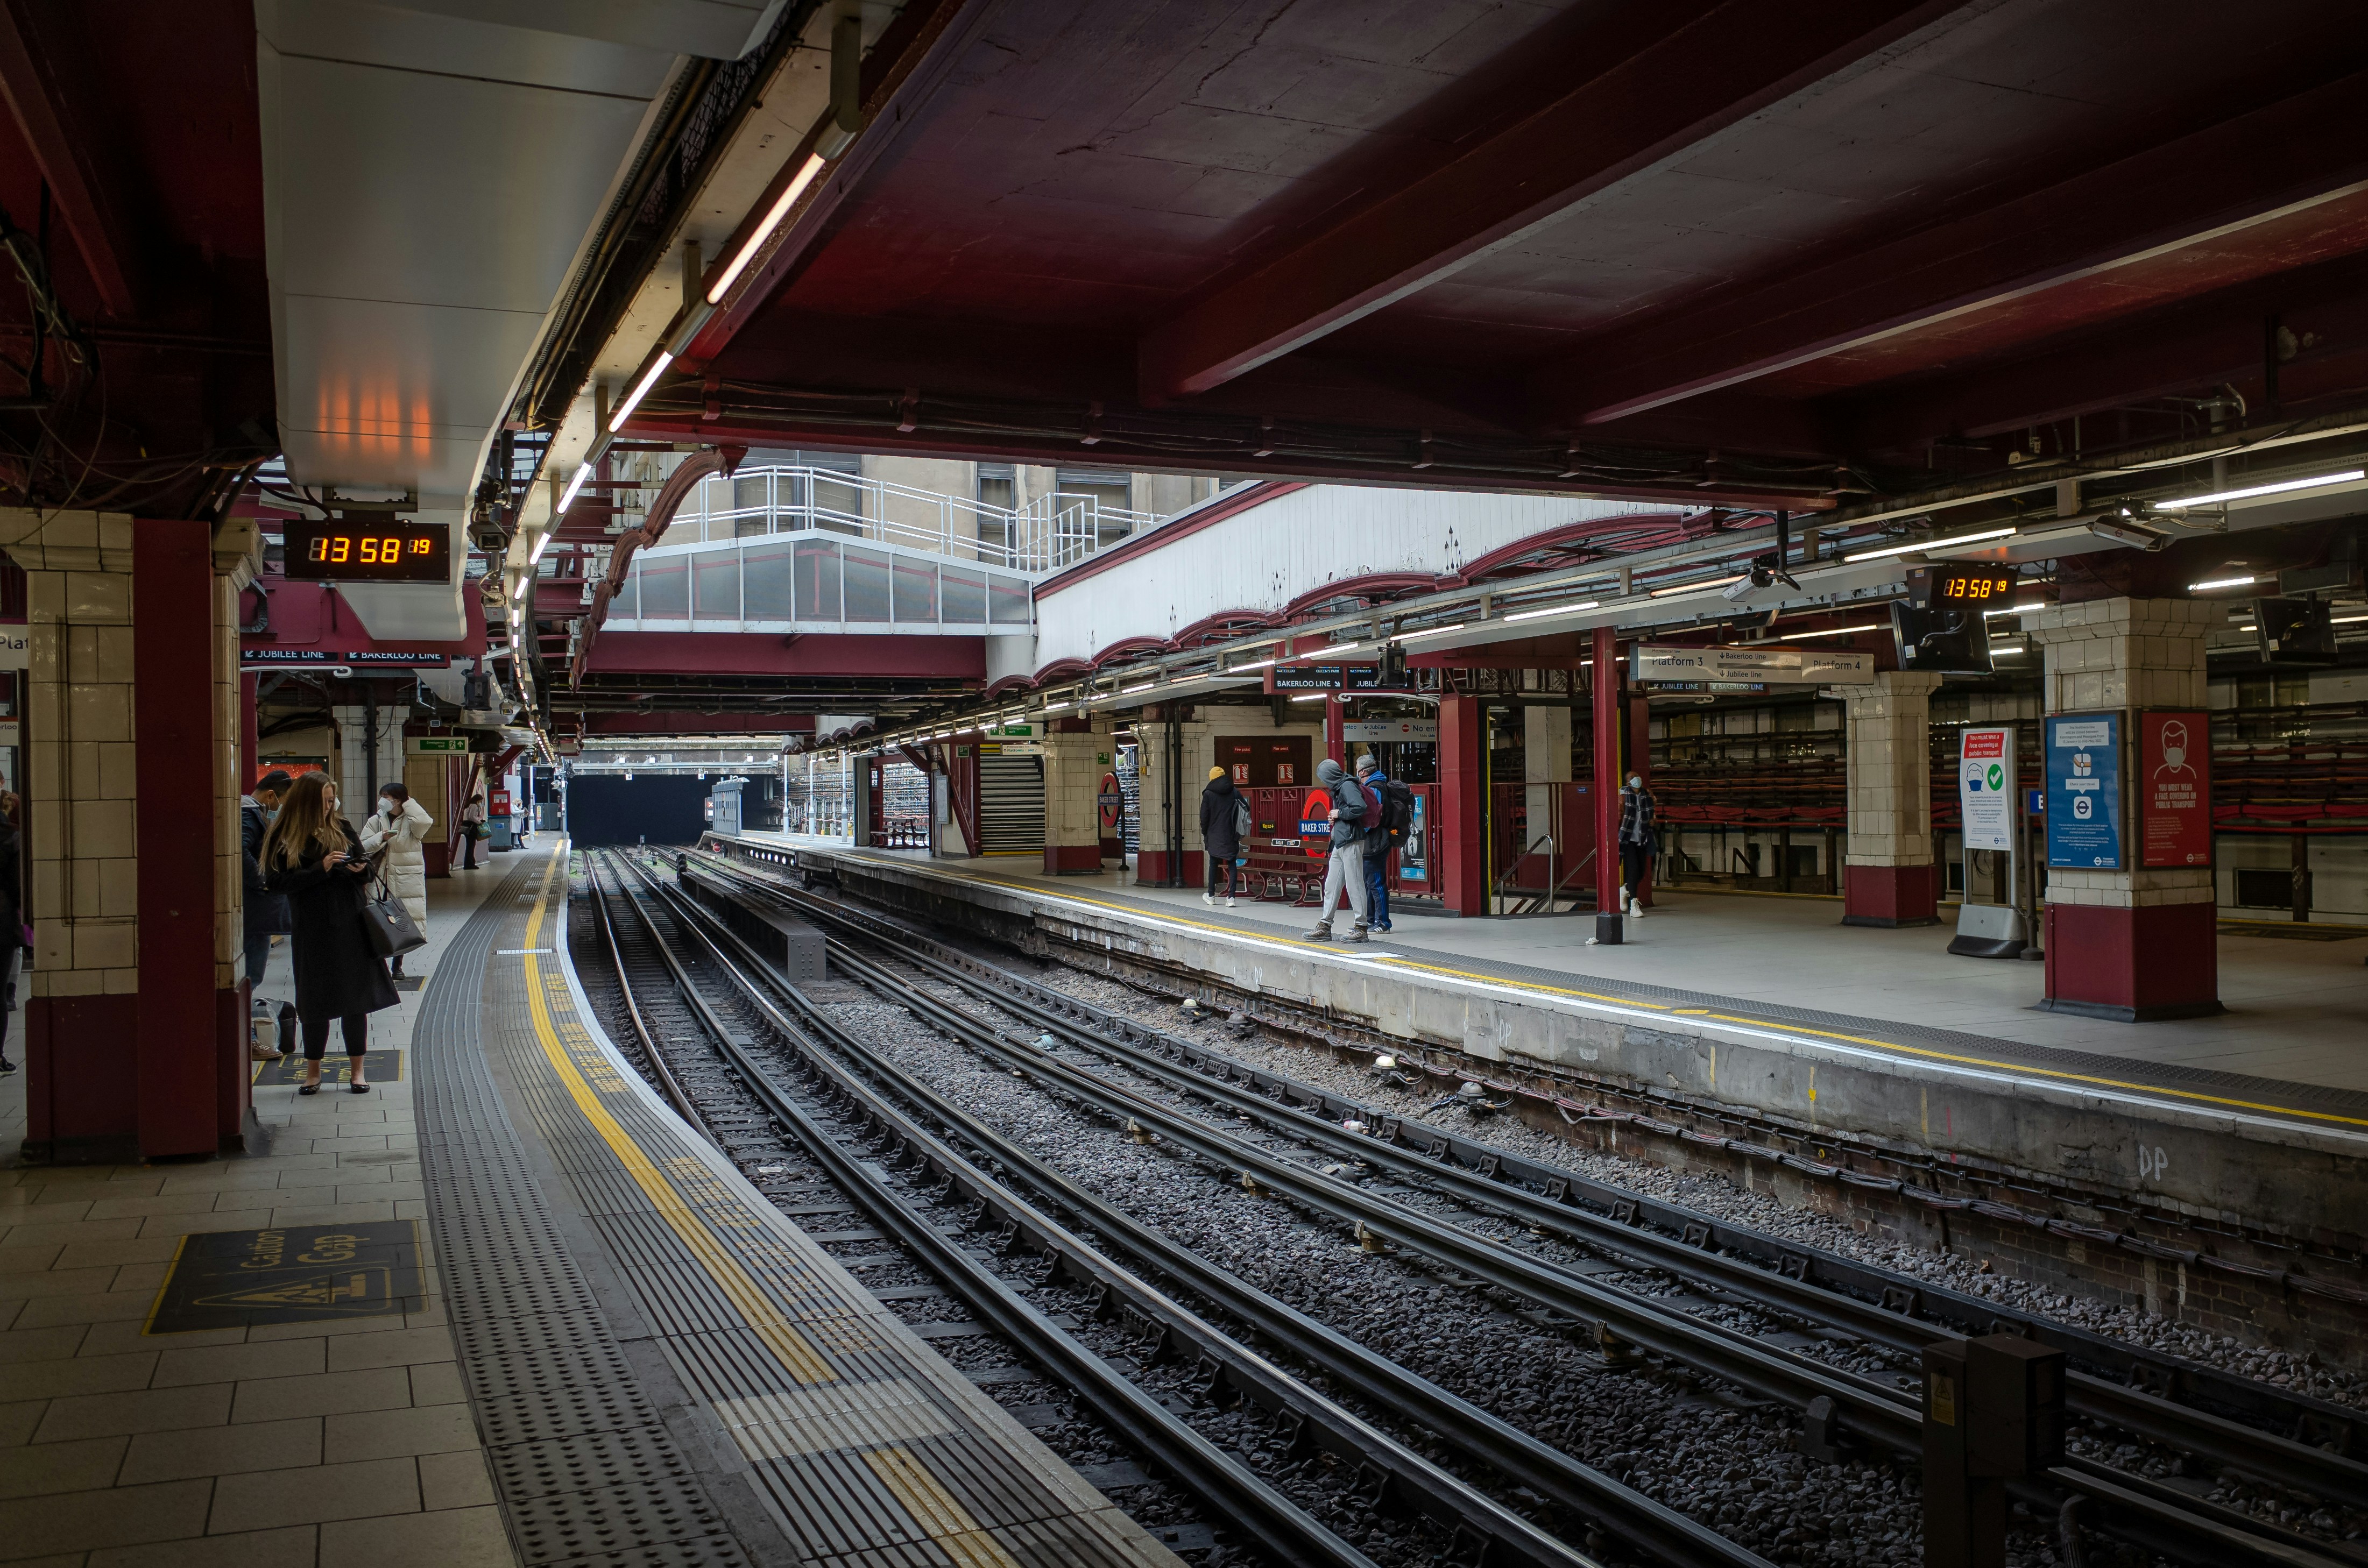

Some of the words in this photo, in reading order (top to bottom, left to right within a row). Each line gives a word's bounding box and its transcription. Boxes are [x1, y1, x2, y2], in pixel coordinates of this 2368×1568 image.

[1652, 656, 1694, 666] Platform
[1698, 657, 1703, 666] 3
[1813, 660, 1852, 670] Platform
[1855, 661, 1860, 670] 4
[1726, 670, 1749, 678] Jubilee
[2169, 792, 2189, 800] COVERING
[1302, 823, 1317, 832] BAKER
[1318, 823, 1330, 833] STRE
[1499, 1018, 1511, 1047] DP
[2139, 1144, 2168, 1181] DP
[240, 1230, 286, 1268] Caution
[297, 1234, 370, 1263] Gap
